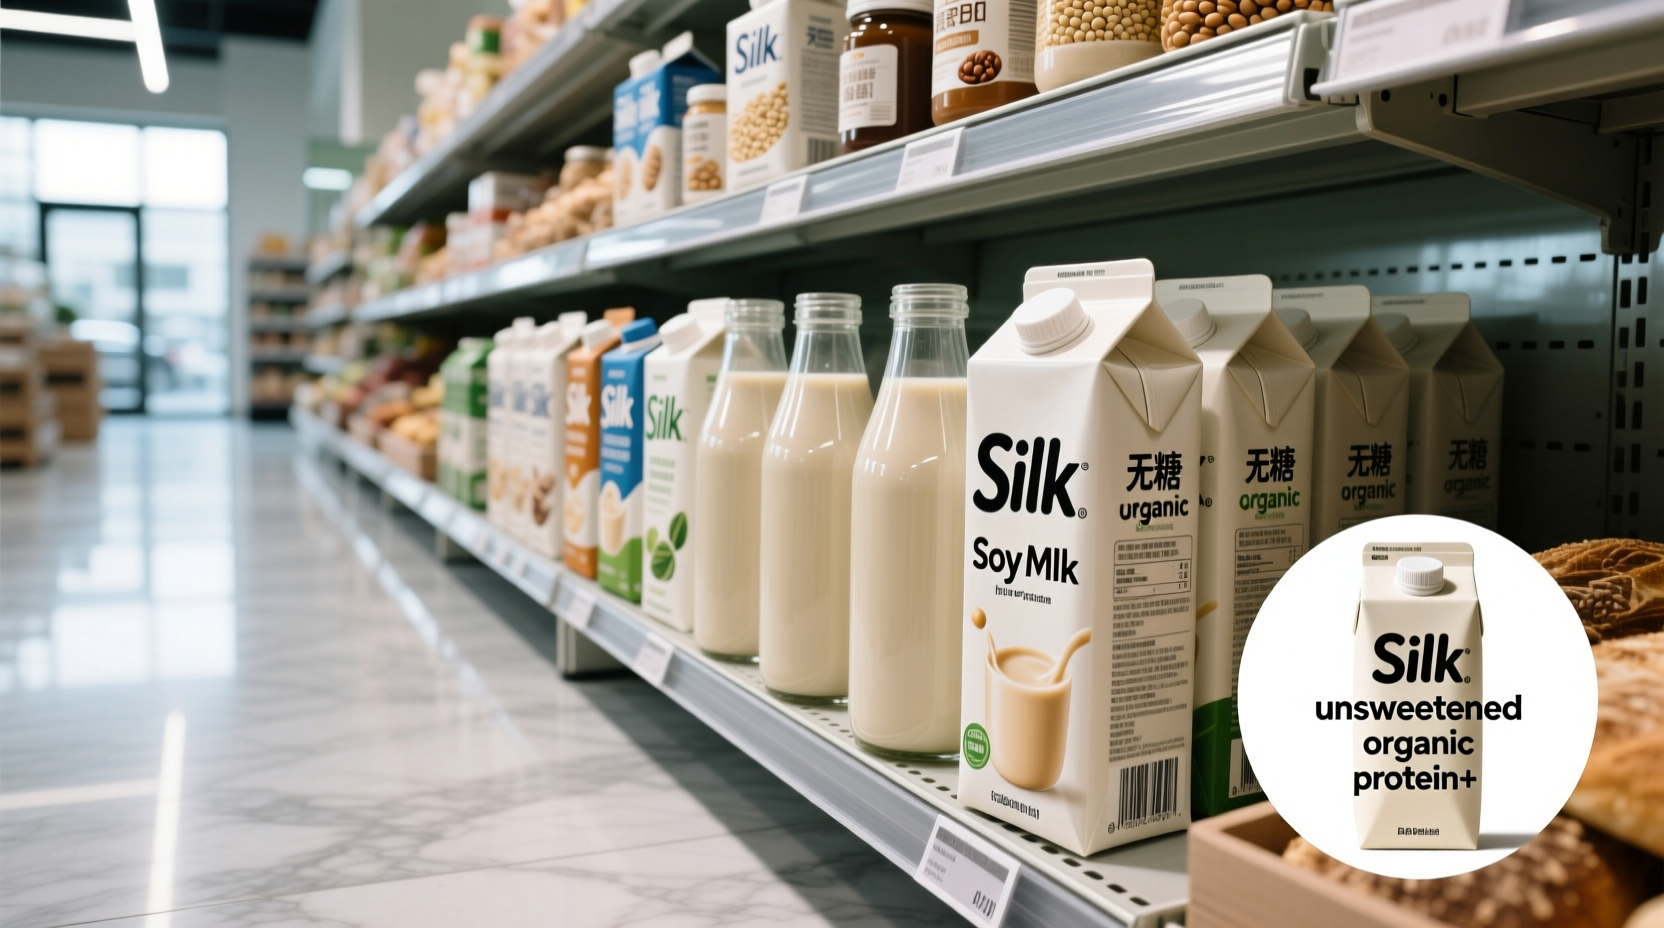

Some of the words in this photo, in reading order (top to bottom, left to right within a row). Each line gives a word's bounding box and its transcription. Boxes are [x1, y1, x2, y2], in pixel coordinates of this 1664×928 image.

[734, 24, 778, 75] Silk
[600, 384, 634, 429] Silk
[646, 394, 684, 441] Silk
[972, 431, 1080, 519] Silk
[1126, 450, 1183, 492] 无糖
[1245, 446, 1295, 484] 无糖
[1347, 441, 1392, 478] 无糖
[1239, 487, 1300, 515] organic
[1341, 479, 1396, 505] organic
[972, 535, 1022, 586] Soy
